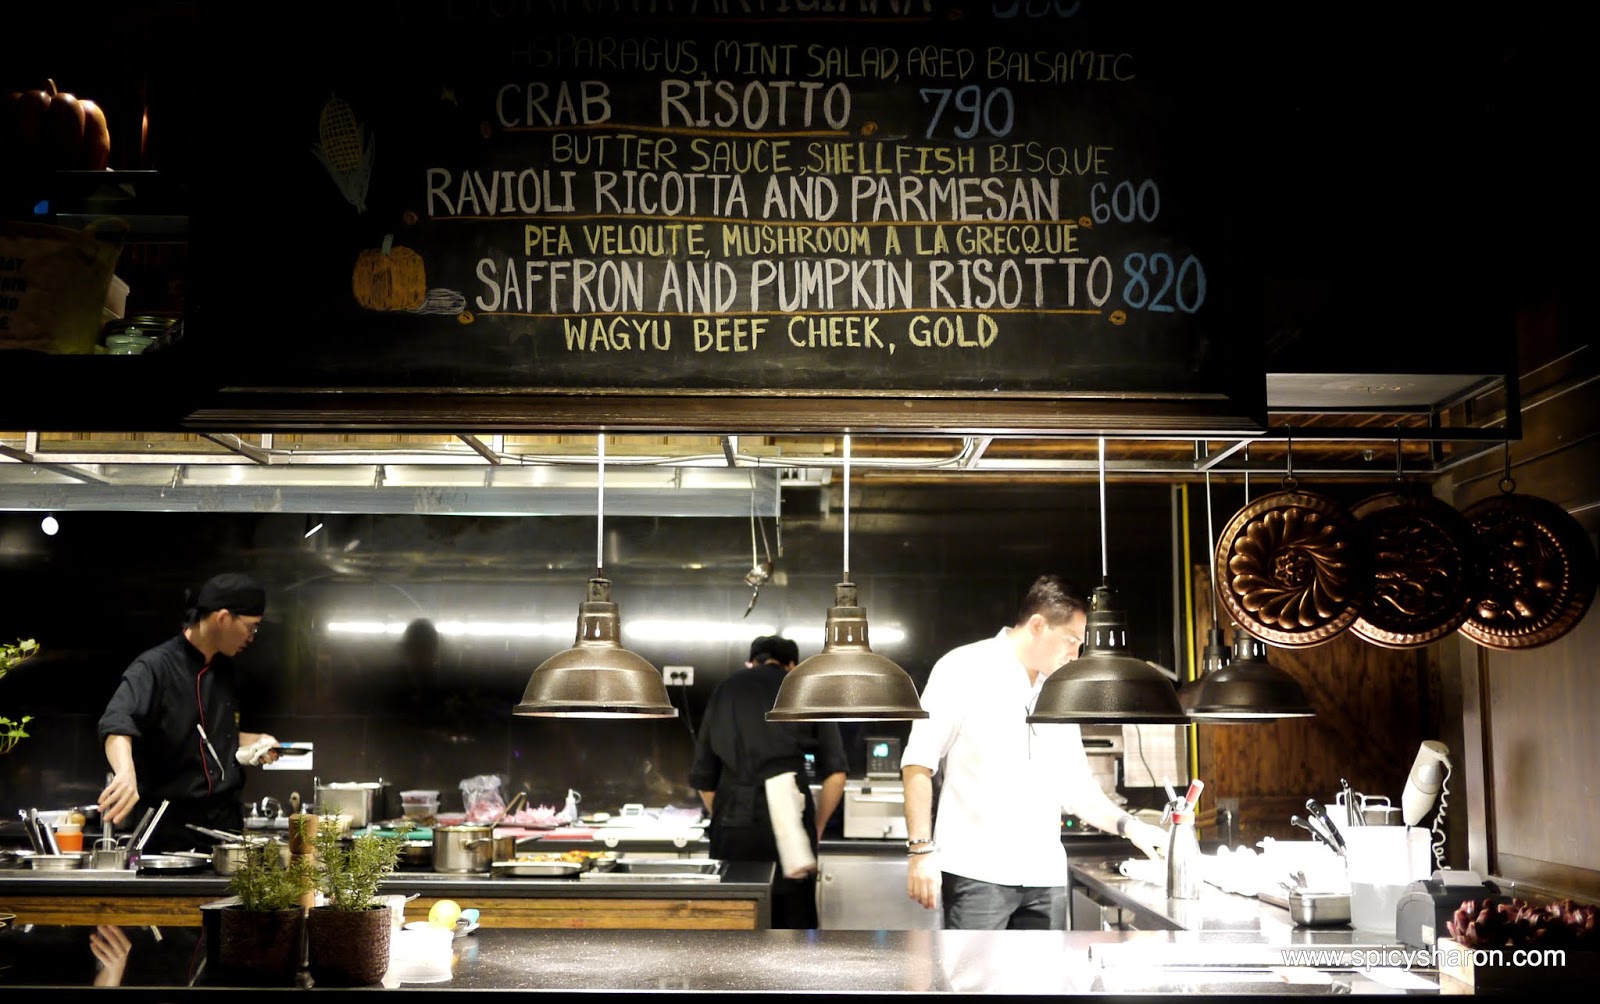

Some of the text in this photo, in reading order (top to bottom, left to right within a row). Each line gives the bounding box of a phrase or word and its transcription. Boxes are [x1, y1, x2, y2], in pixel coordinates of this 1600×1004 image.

[714, 39, 798, 76] MINT
[805, 45, 899, 83] SALAD,
[986, 46, 1137, 84] BALSAMIC
[495, 79, 1016, 140] CRAB RISOTTO 790
[551, 133, 678, 170] BUTTER
[989, 141, 1114, 176] BISQUE
[426, 166, 1161, 224] RAVIOLI RICOTTA AND PARMESAN 600
[524, 223, 1081, 260] PEA VELOUTE, MUSHROOM A LA GRECQUE
[475, 251, 1208, 315] SAFFRON AND PUMPKIN RISOTTO 820
[563, 314, 1000, 355] WAGYU BEEF CHEEK, GOLD
